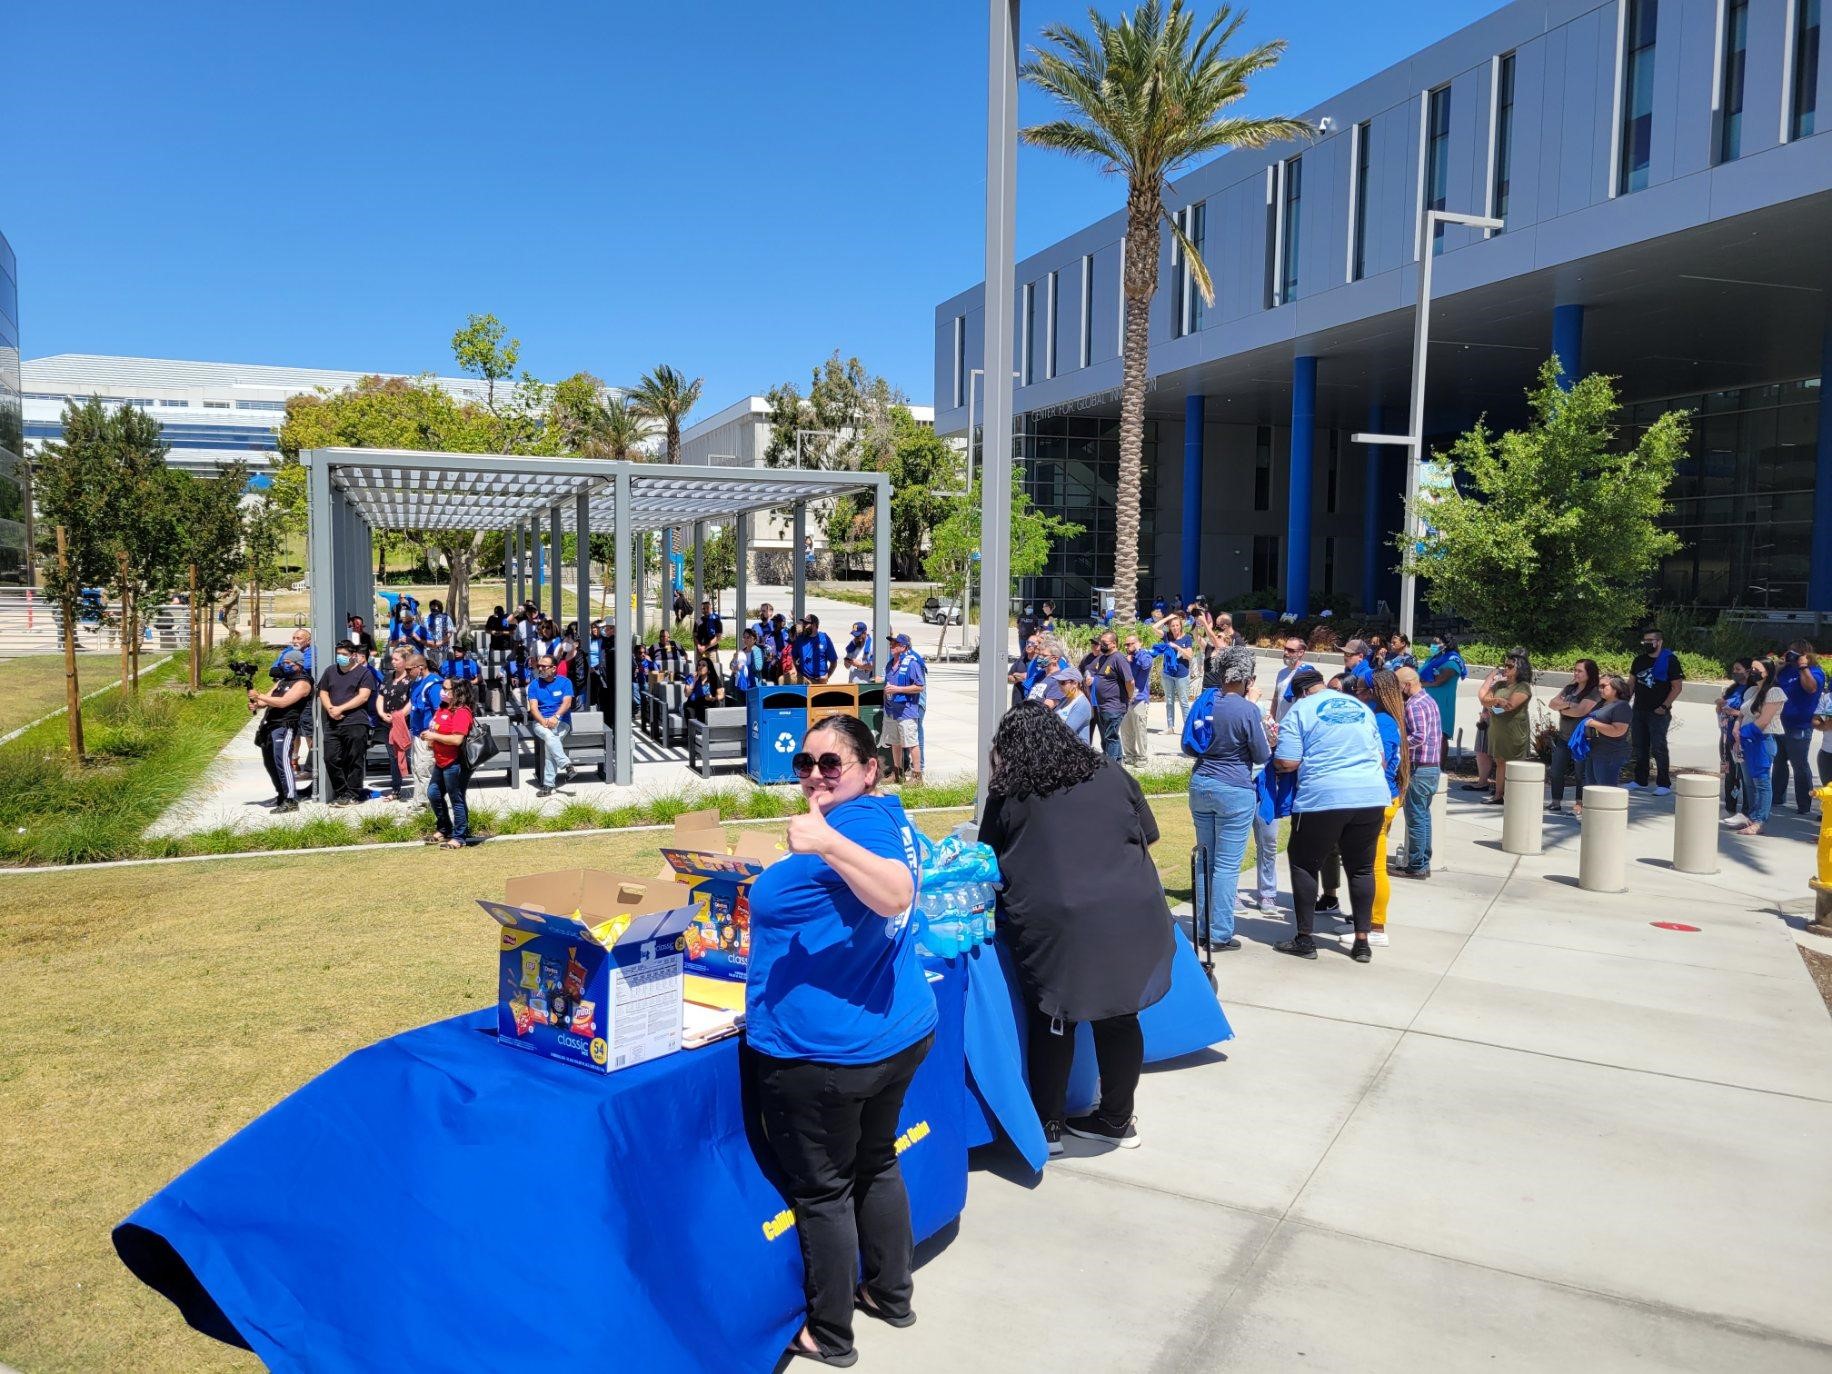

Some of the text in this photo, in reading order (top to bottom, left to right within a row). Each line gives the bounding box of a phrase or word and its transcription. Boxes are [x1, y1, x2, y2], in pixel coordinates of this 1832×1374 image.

[1031, 405, 1056, 422] CENTER
[1059, 400, 1076, 415] FOR
[1077, 392, 1106, 411] GLOBAL
[727, 953, 748, 966] class
[557, 1033, 589, 1052] classic
[594, 1041, 604, 1056] 54
[762, 1209, 796, 1241] Califo
